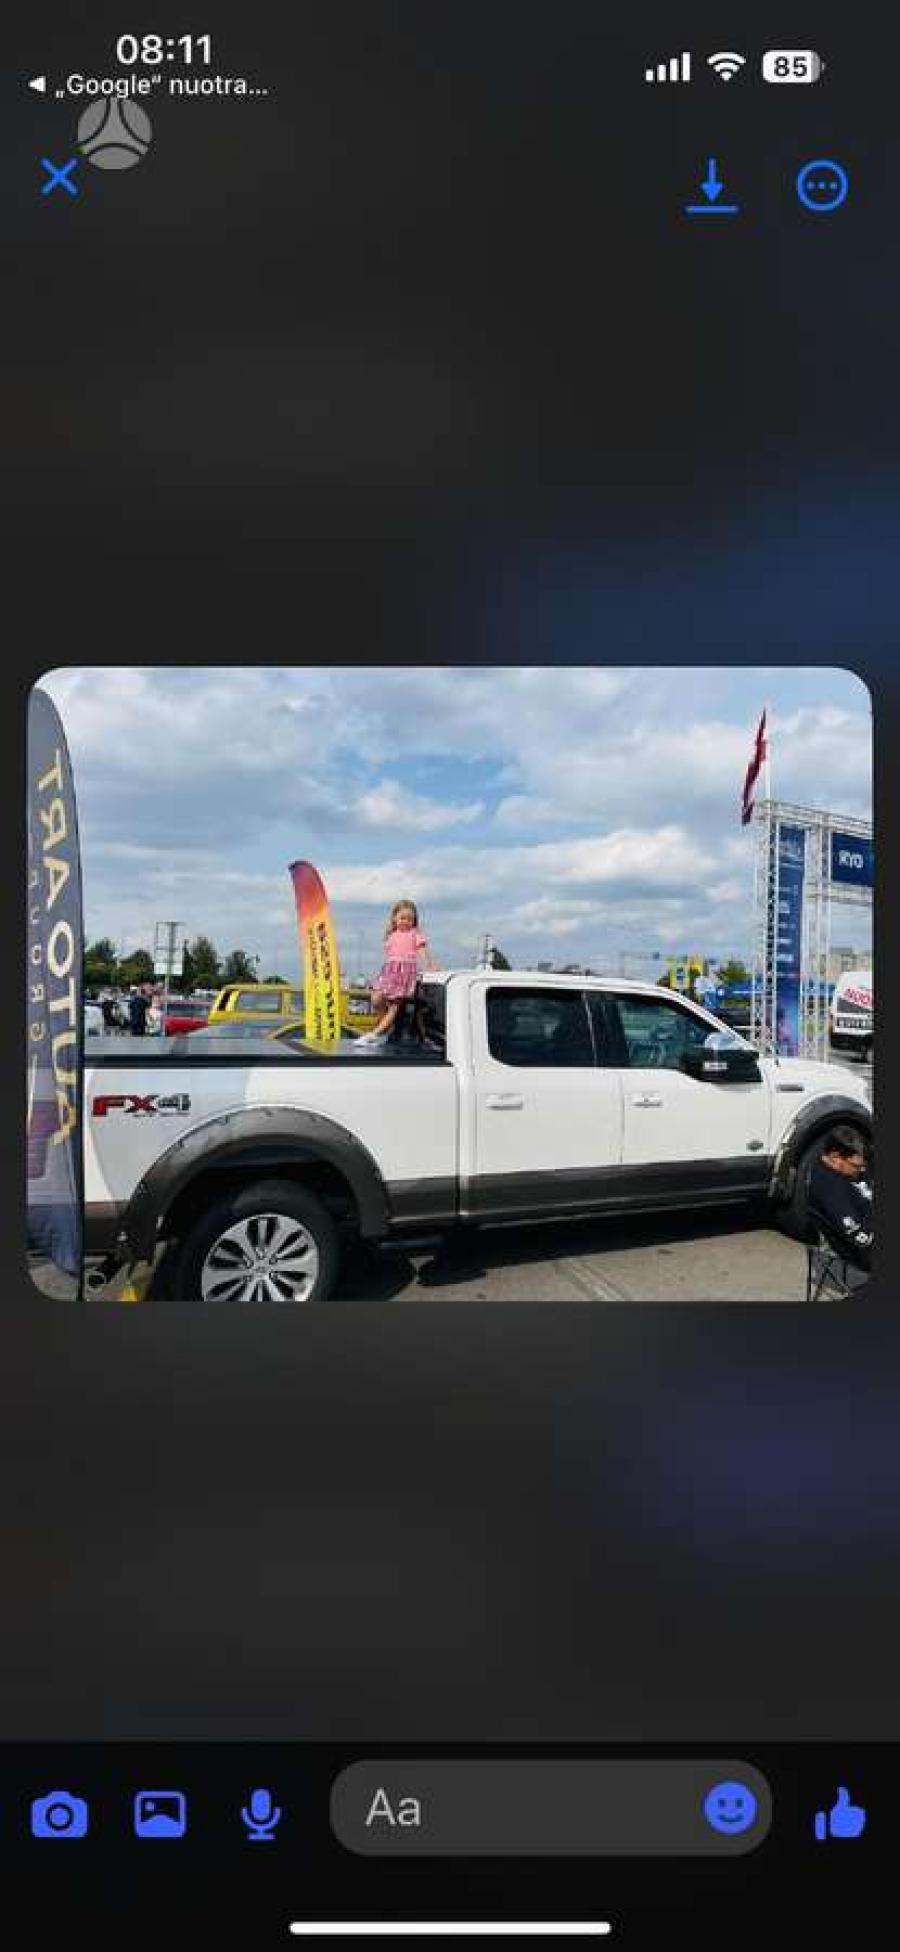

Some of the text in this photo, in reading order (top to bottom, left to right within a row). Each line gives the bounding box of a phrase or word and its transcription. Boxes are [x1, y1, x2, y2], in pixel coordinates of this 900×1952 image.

[116, 34, 211, 65] 08:11
[773, 56, 808, 77] 85
[91, 1094, 191, 1116] FX4
[365, 1789, 420, 1825] Aa
